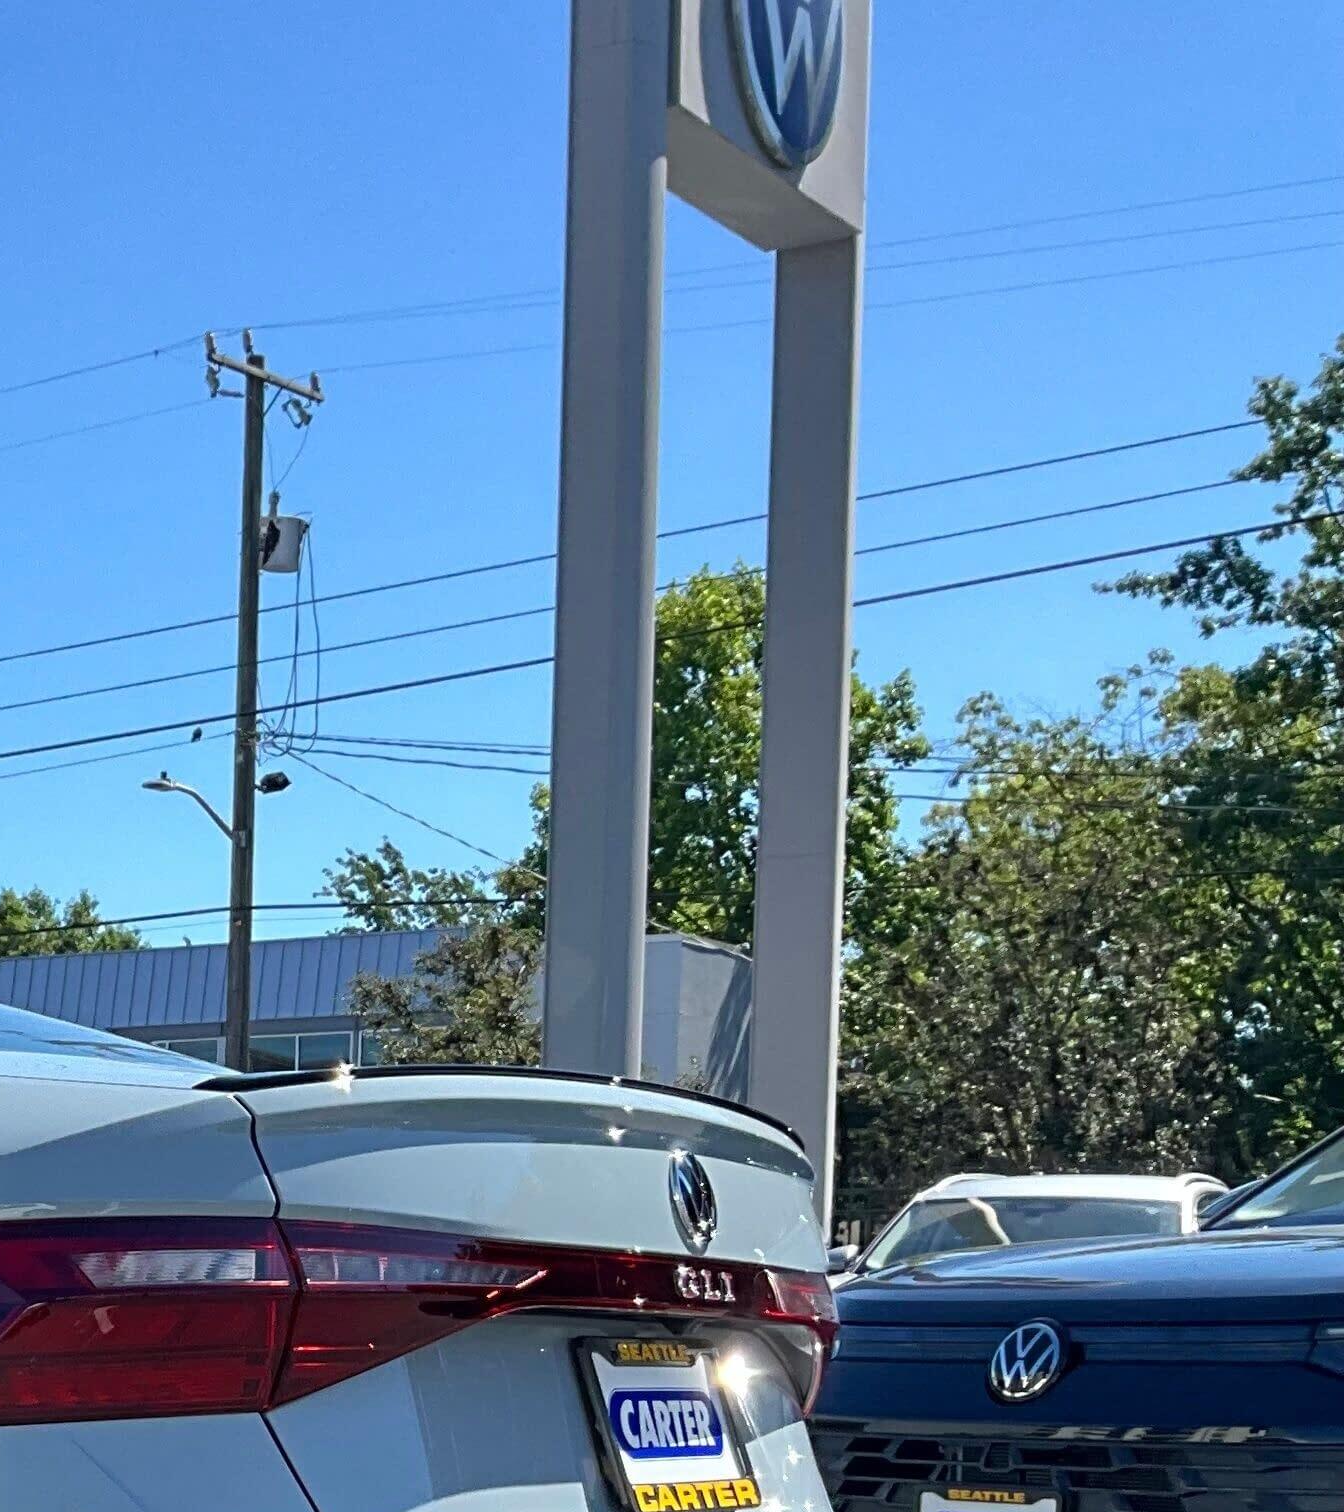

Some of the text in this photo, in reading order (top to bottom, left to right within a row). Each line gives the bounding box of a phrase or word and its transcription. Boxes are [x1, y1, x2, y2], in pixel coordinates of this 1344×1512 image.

[675, 1266, 736, 1303] GLI
[616, 1342, 690, 1363] SEATTLE
[620, 1398, 716, 1449] CARTER
[948, 1488, 1026, 1503] SEATTLE
